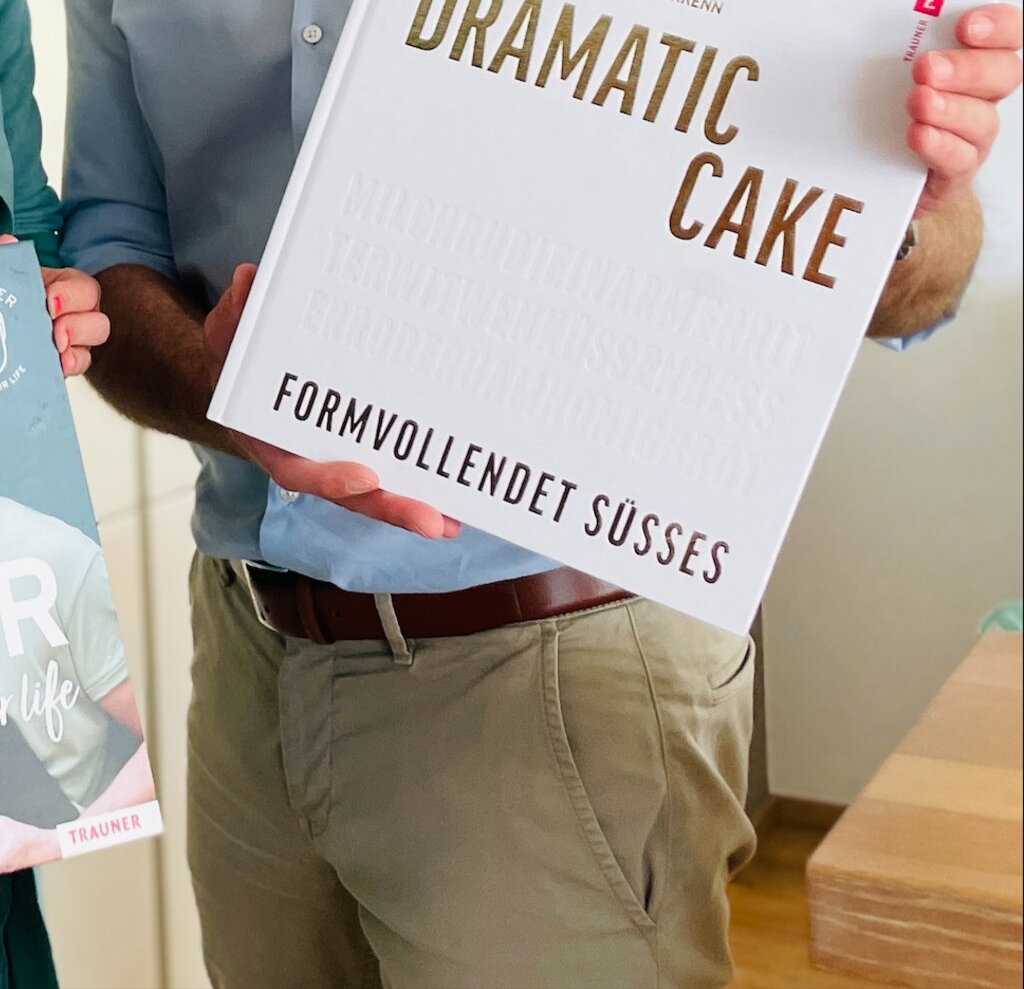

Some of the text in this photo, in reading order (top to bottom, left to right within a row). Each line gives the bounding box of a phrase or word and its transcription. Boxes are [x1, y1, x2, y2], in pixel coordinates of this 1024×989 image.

[903, 18, 928, 63] TRAUNER
[668, 151, 865, 289] CAKE
[8, 364, 26, 384] LIFE
[272, 372, 730, 585] FORMVOLLENDET SÜSSES
[21, 659, 80, 743] life
[68, 814, 142, 844] TRAUNER
